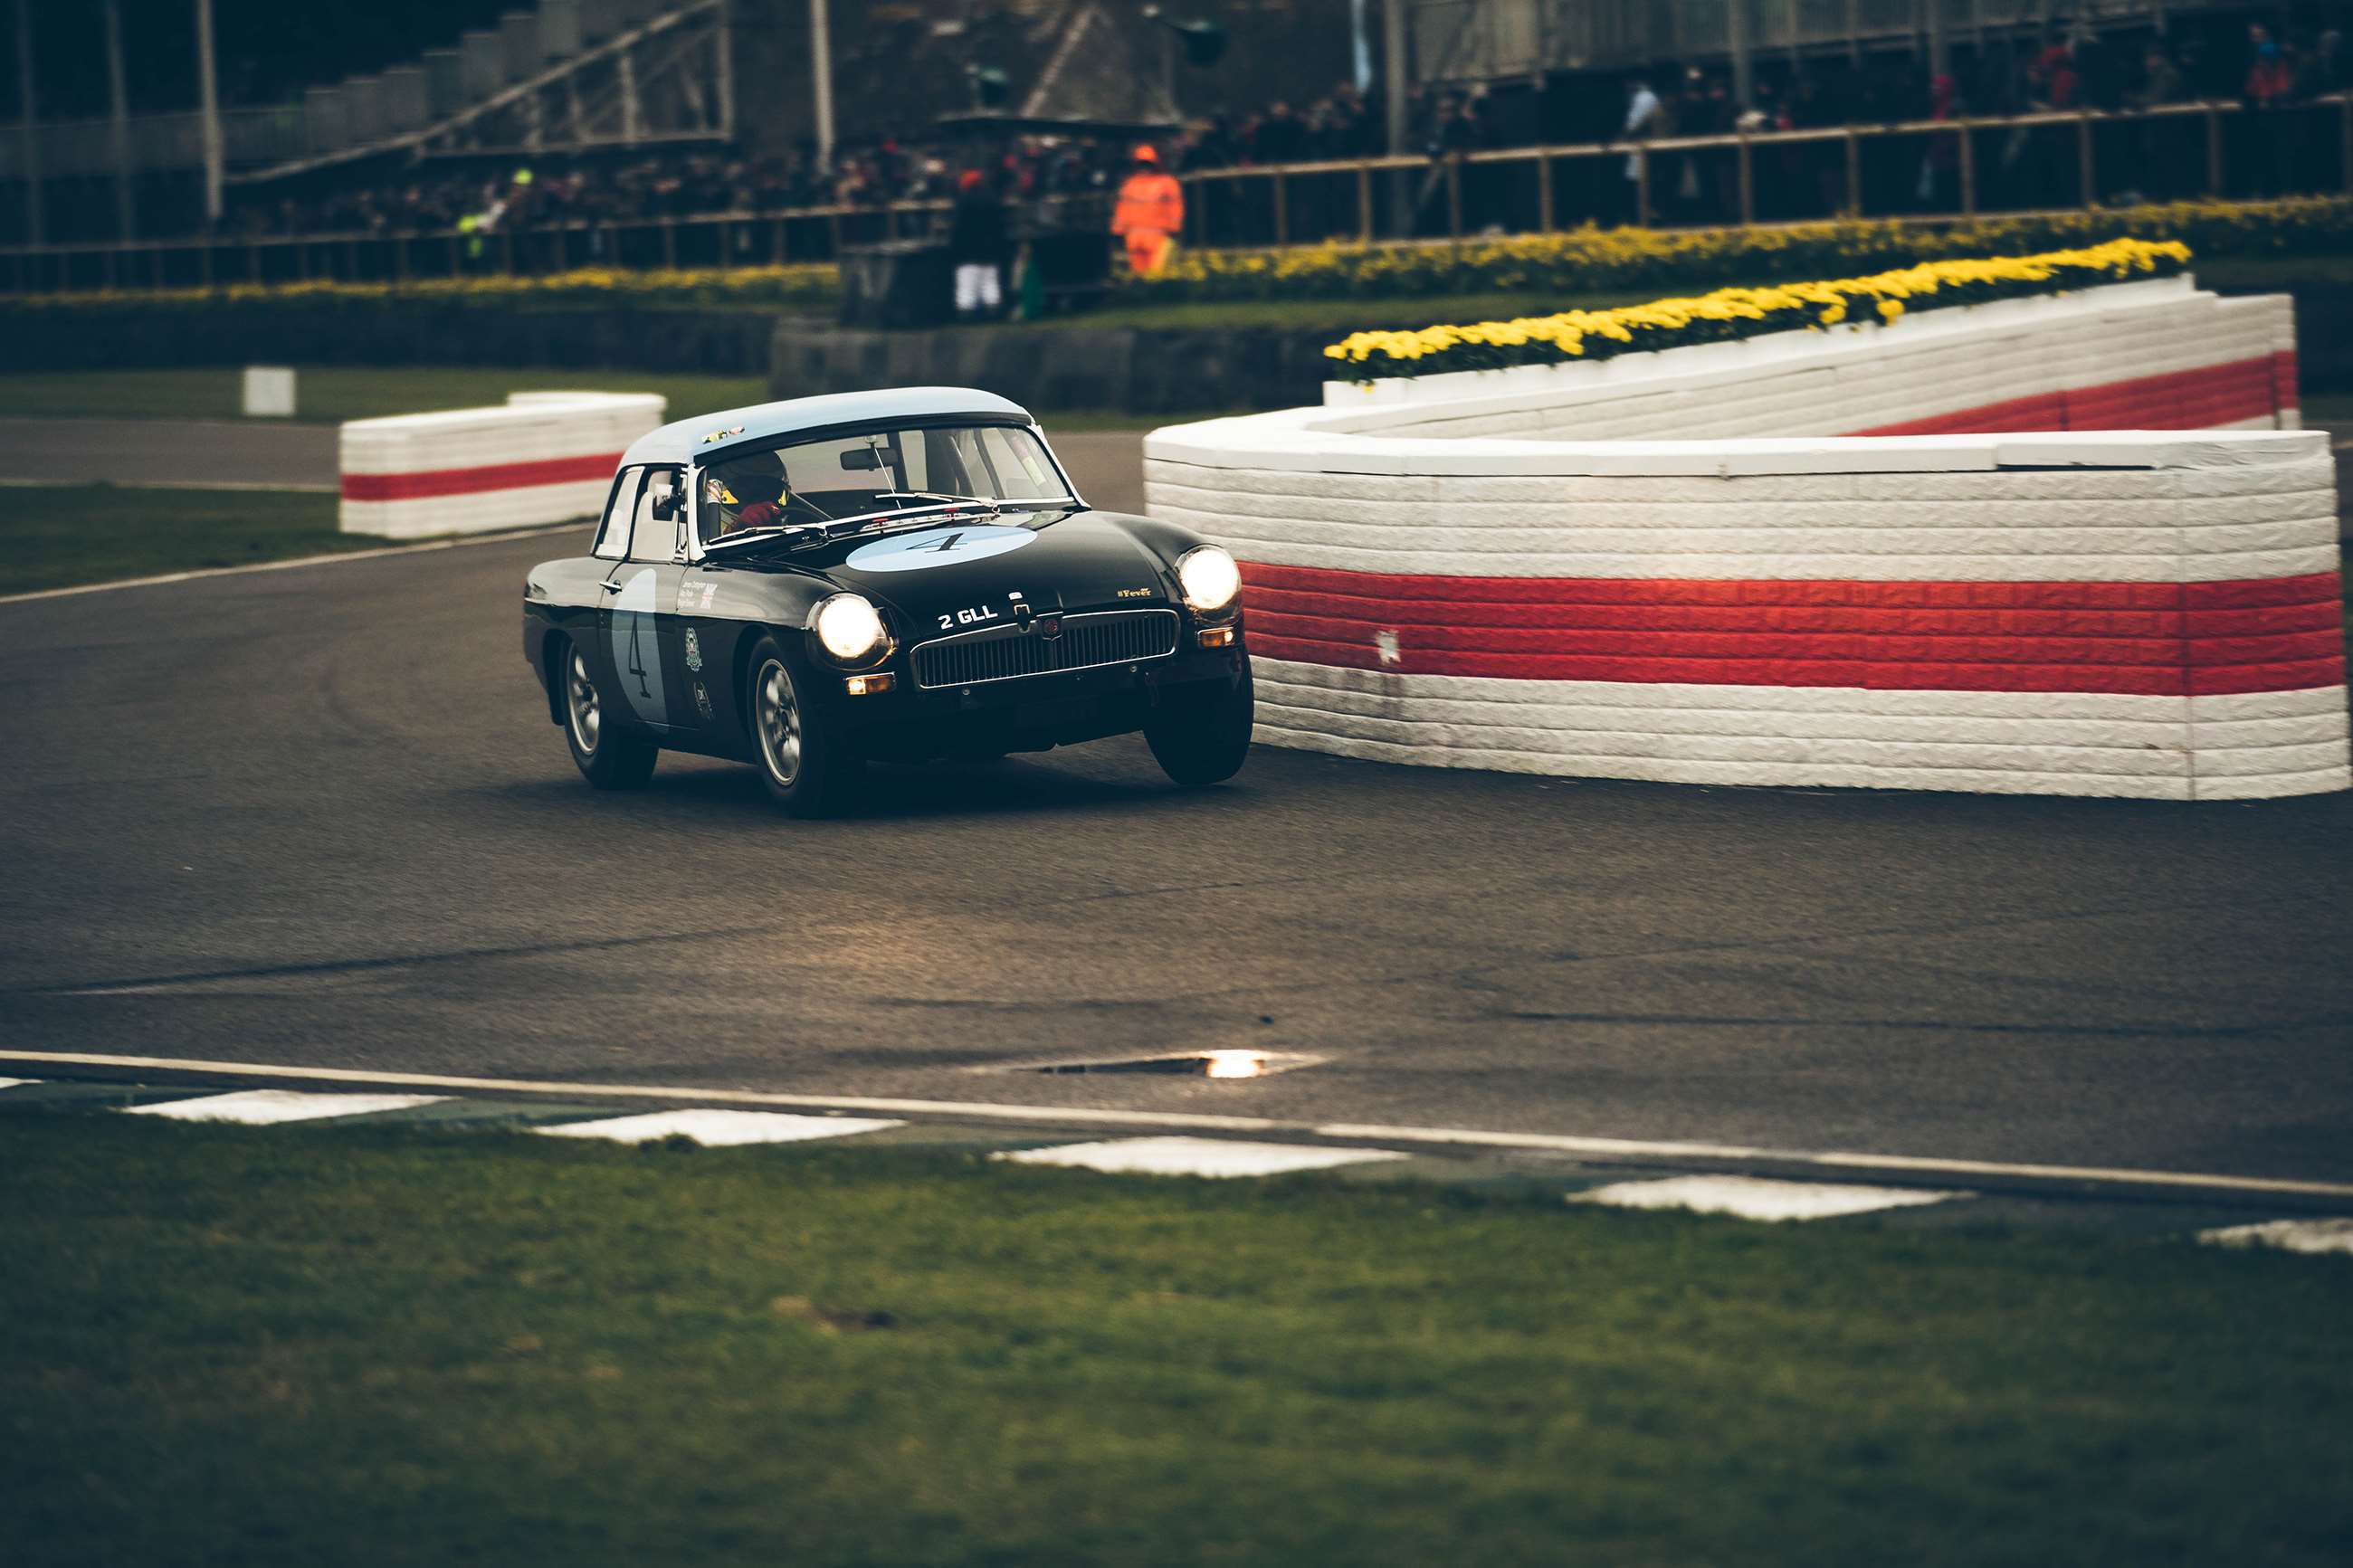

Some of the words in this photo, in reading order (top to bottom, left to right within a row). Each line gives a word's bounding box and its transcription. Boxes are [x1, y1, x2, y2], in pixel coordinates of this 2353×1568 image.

[905, 532, 967, 553] 4
[1117, 588, 1151, 597] #Fever
[938, 614, 954, 630] 2
[957, 605, 998, 624] GLL
[629, 611, 652, 698] 4
